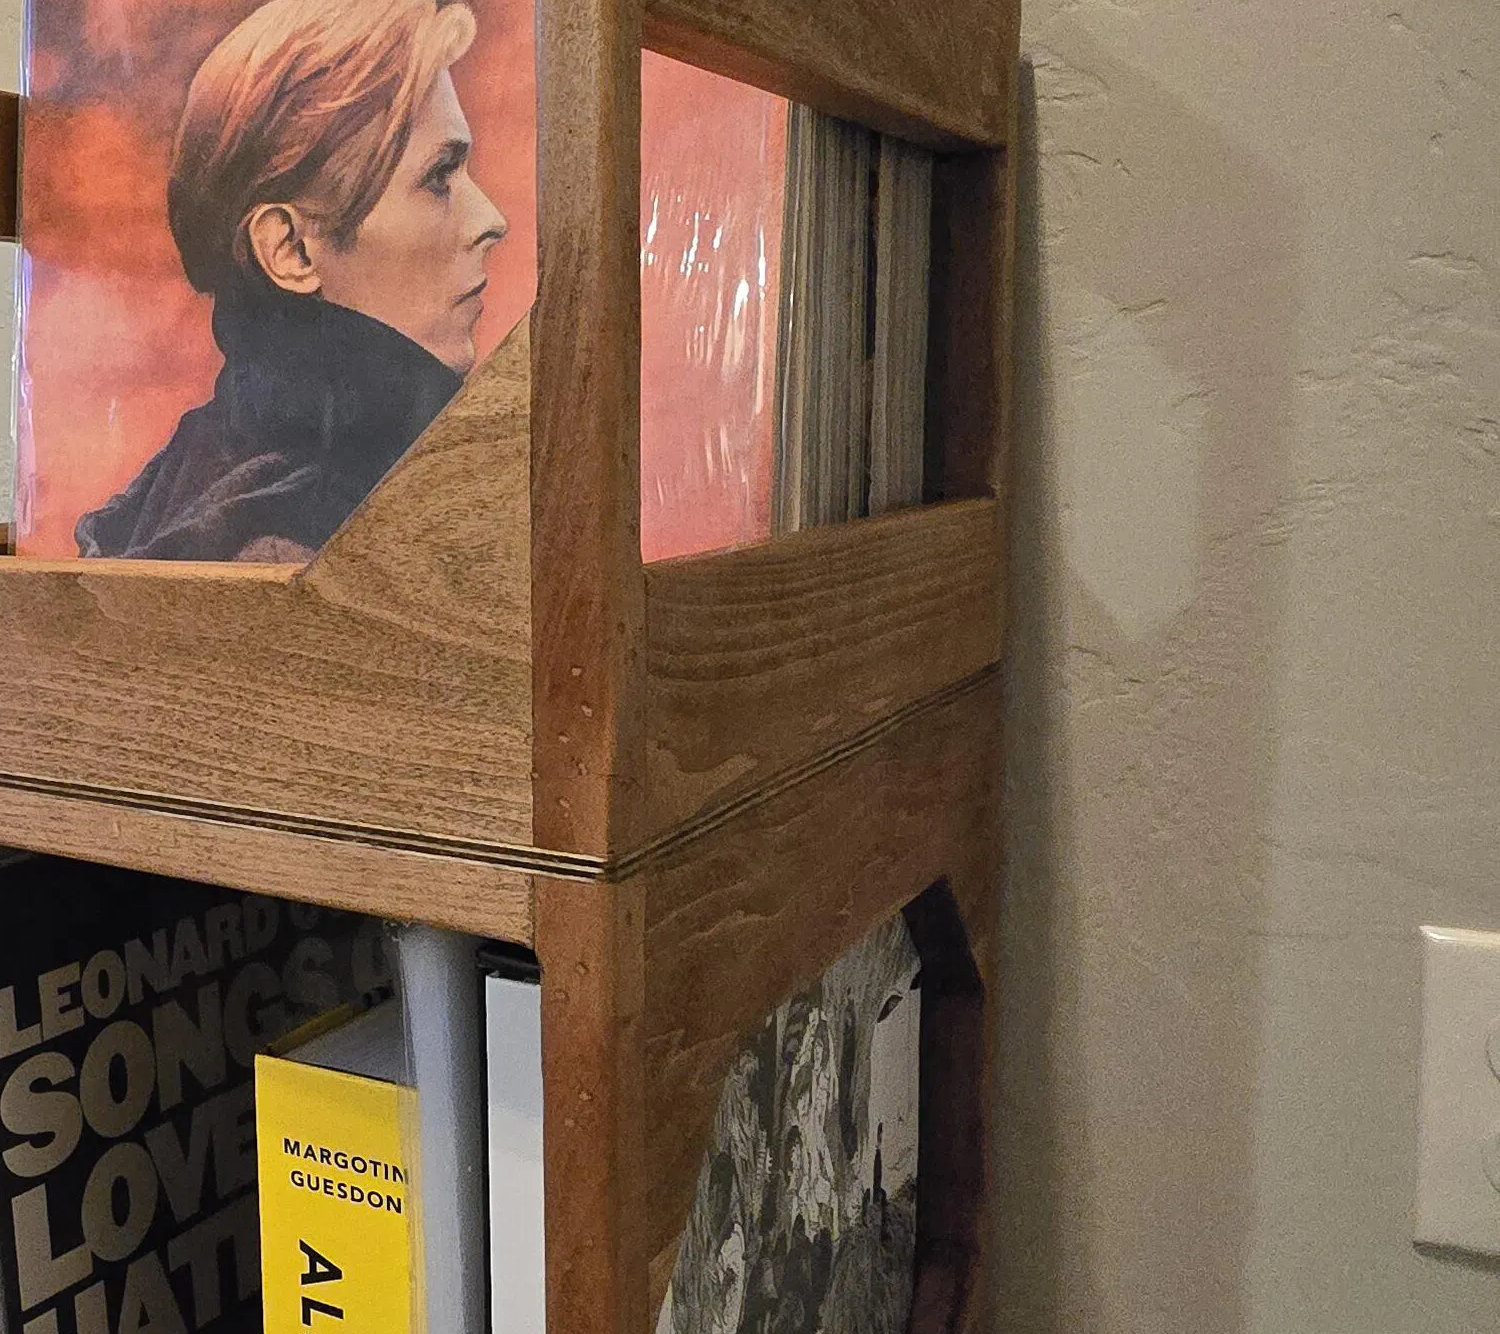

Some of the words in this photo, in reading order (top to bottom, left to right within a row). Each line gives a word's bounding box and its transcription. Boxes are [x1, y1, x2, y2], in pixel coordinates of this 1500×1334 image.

[0, 935, 342, 1179] SONGS
[282, 1138, 409, 1185] MARGOTIN
[290, 1169, 404, 1215] GUESDON
